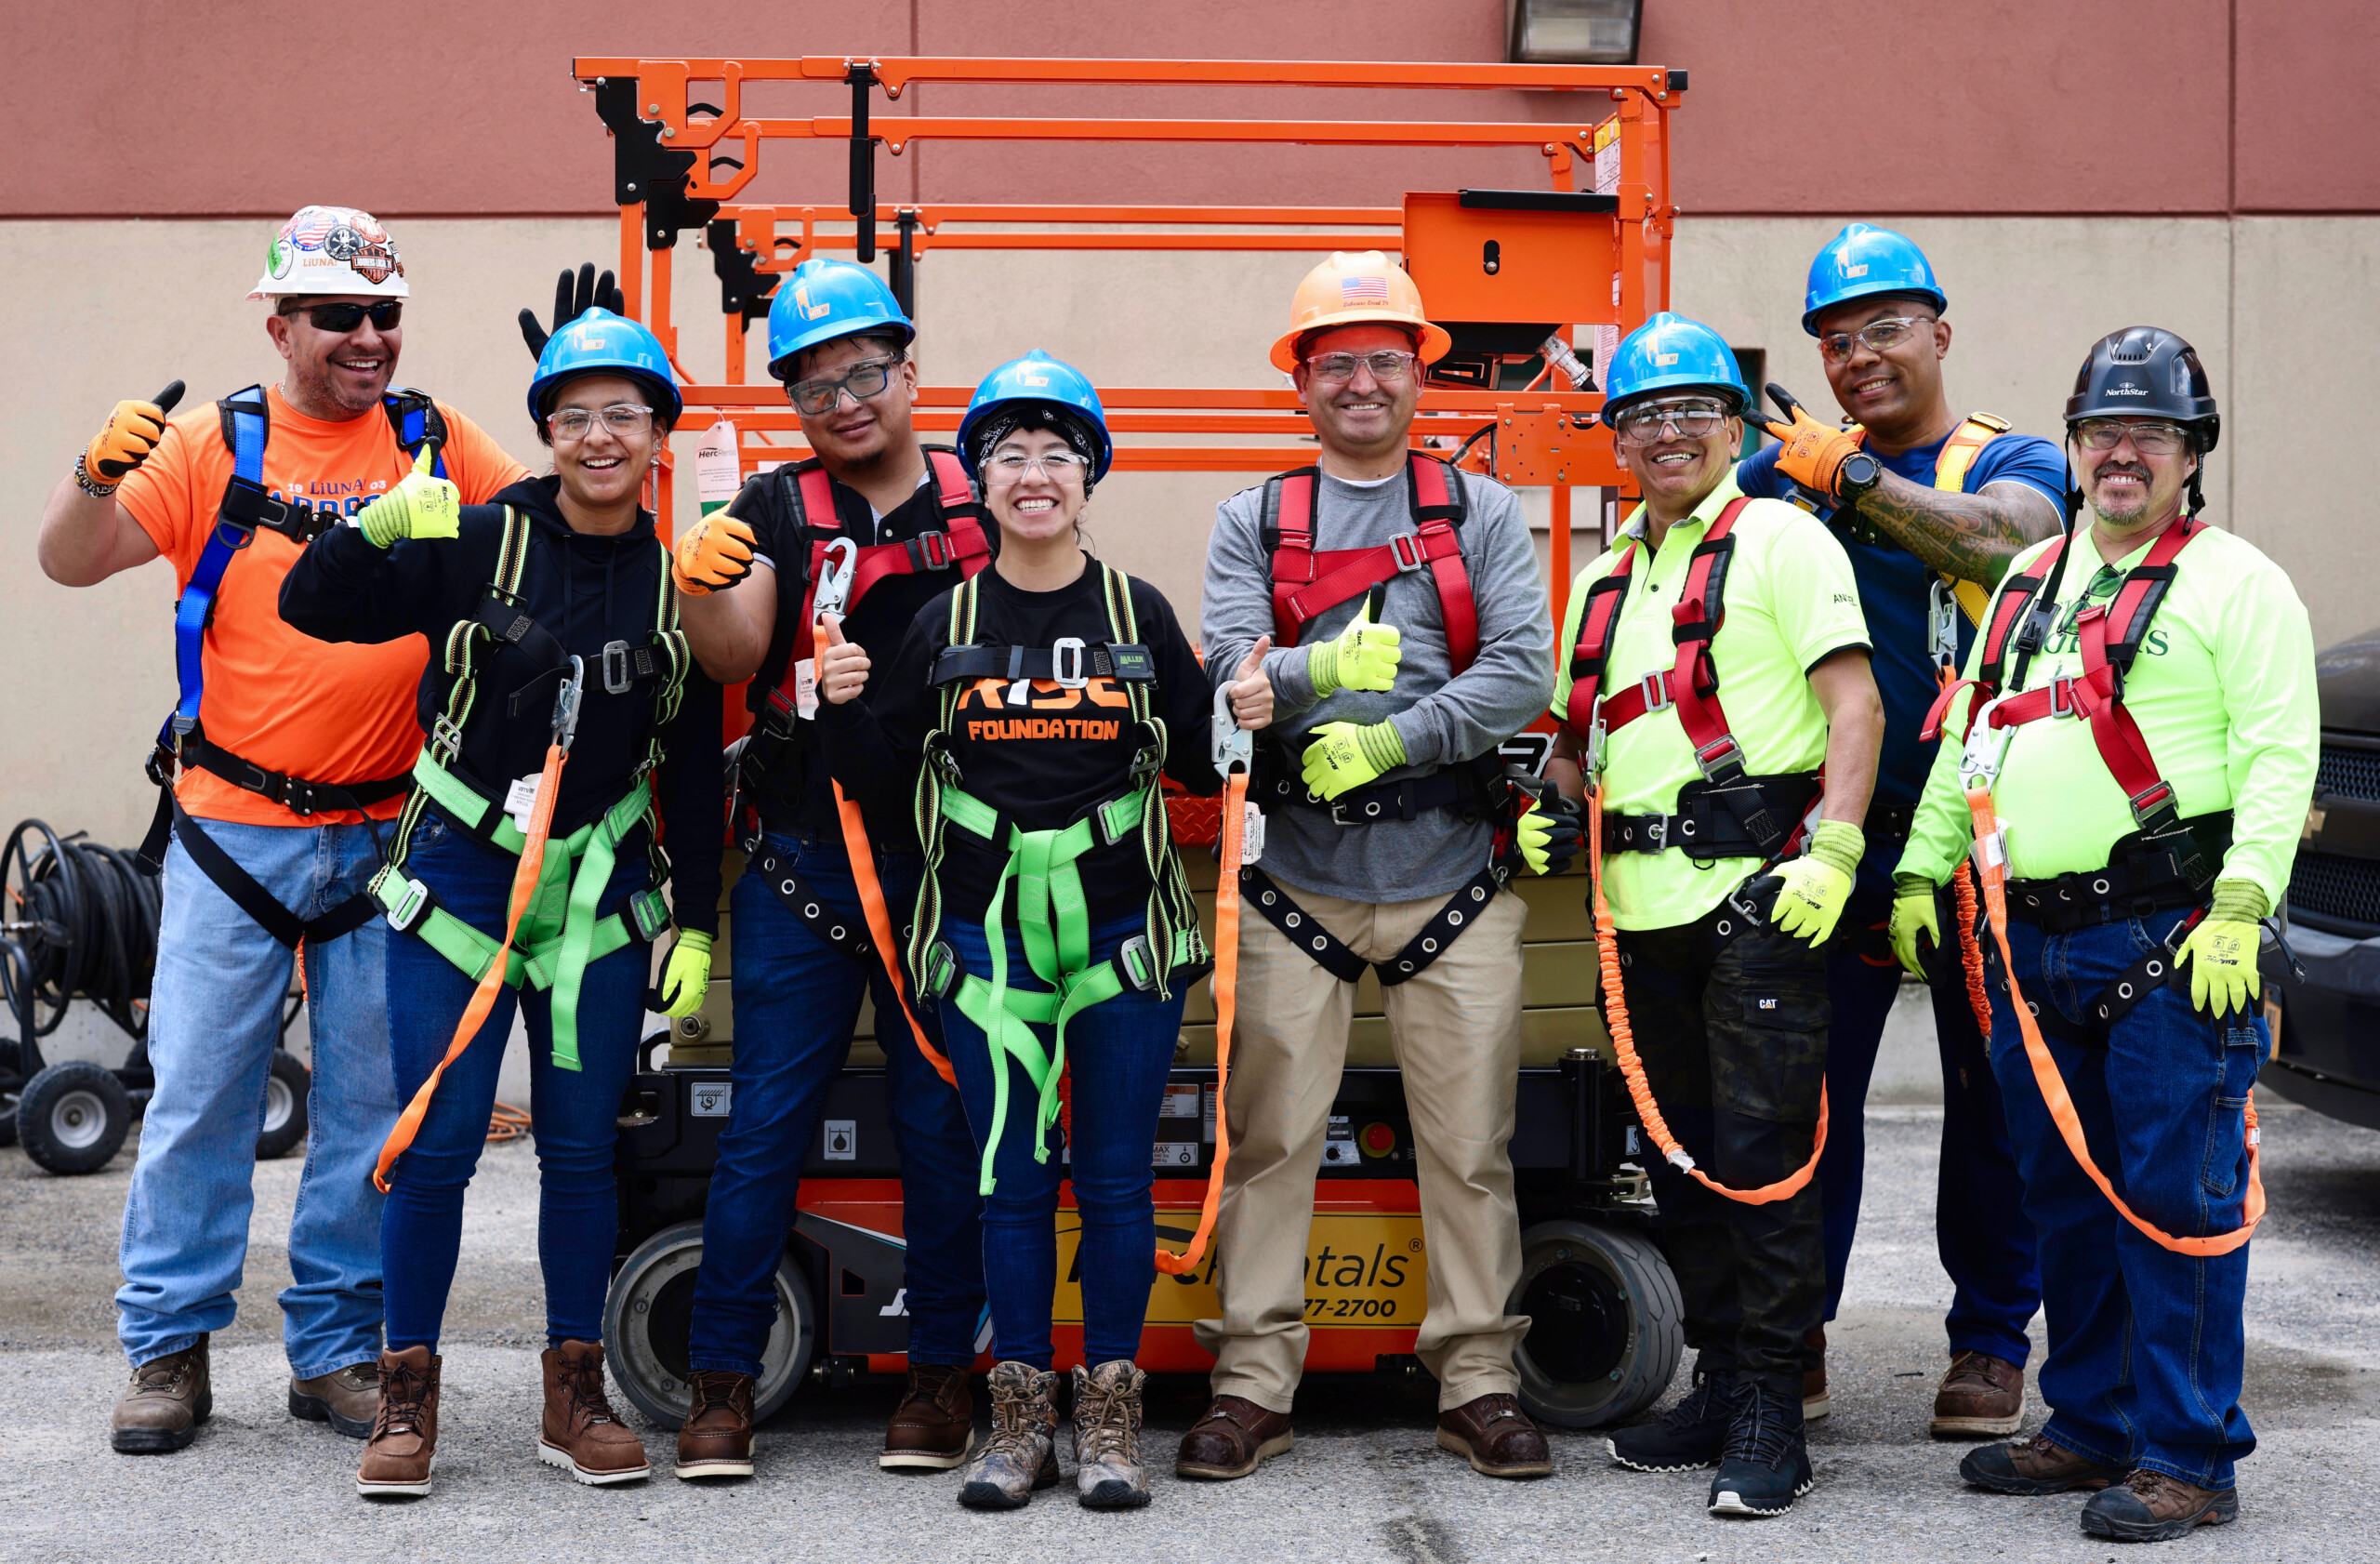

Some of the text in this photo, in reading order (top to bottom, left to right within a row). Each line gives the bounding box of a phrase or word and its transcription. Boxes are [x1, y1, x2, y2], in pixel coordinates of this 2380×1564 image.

[303, 258, 337, 267] LiUNA!
[2105, 388, 2149, 396] NorthStar
[287, 478, 387, 495] 19 LiUNA! 03
[1119, 655, 1144, 665] MILLER
[968, 718, 1120, 741] FOUNDATION
[1759, 999, 1776, 1009] CAT
